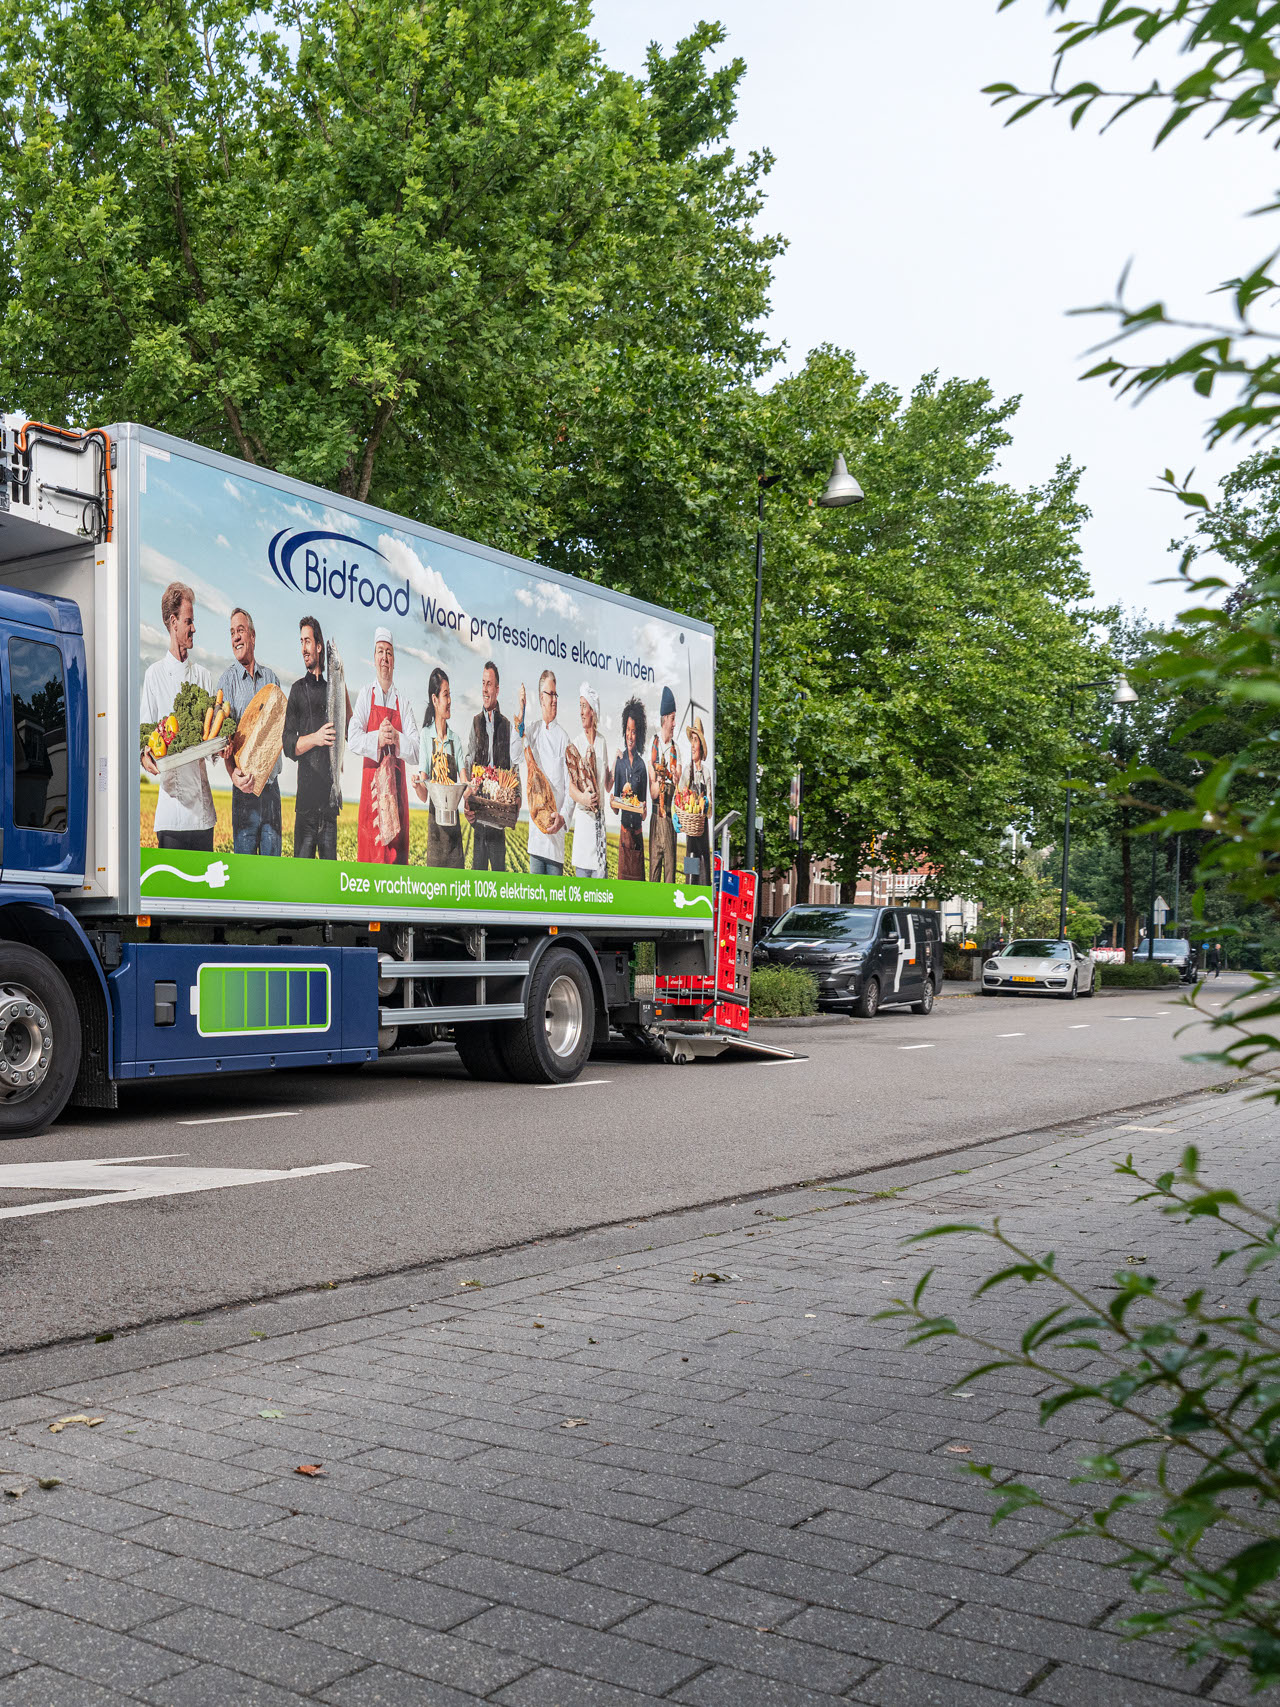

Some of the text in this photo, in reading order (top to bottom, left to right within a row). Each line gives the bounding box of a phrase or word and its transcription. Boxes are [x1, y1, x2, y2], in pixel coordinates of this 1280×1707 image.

[305, 549, 410, 617] Bidfood
[421, 594, 655, 683] Waar professionals elkaar vinden
[340, 872, 614, 904] Deze vrachtwagen rijdt 100% elektrisch, met 0% emissie
